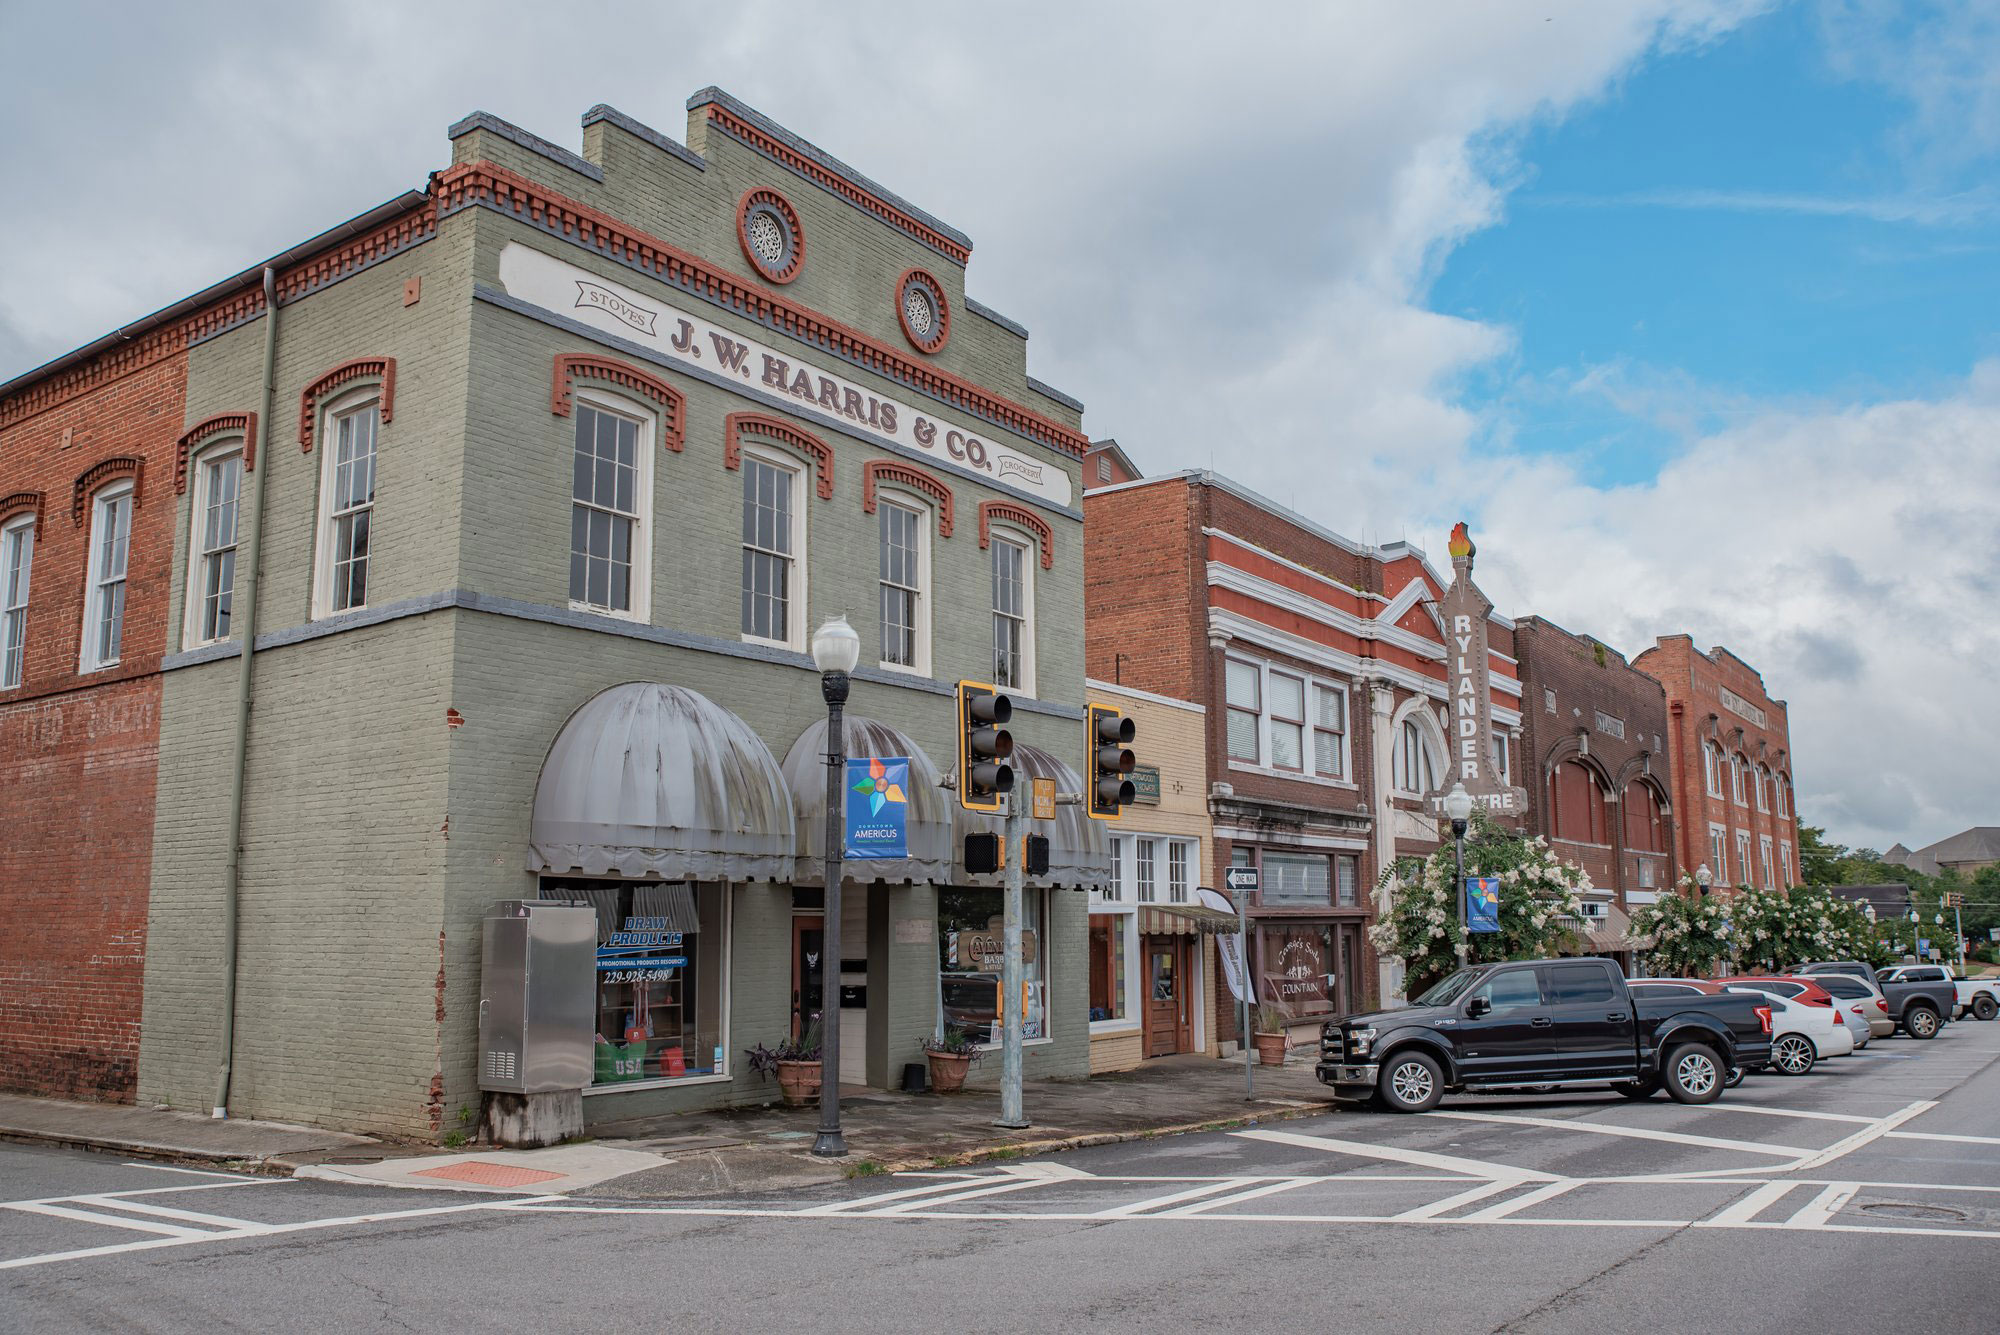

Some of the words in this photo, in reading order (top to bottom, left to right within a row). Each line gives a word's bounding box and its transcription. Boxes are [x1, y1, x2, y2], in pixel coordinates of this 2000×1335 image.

[590, 291, 645, 326] STOVES
[670, 318, 701, 358] J.
[708, 330, 751, 378] W.
[761, 353, 898, 434] HARRIS
[913, 416, 938, 448] &
[945, 430, 992, 472] CO.
[1003, 460, 1040, 479] CROCKERY
[1454, 615, 1479, 779] RYLANDER
[854, 829, 898, 838] AMERICUS
[1236, 874, 1245, 883] ONE
[1246, 874, 1256, 883] WAY
[624, 916, 668, 930] DRAW
[608, 931, 683, 946] PRODUCTS
[602, 959, 636, 967] PROMOTIONAL
[603, 969, 669, 985] 229-928-5498
[1282, 982, 1319, 998] FOUNTAIN
[615, 1058, 642, 1076] USA
